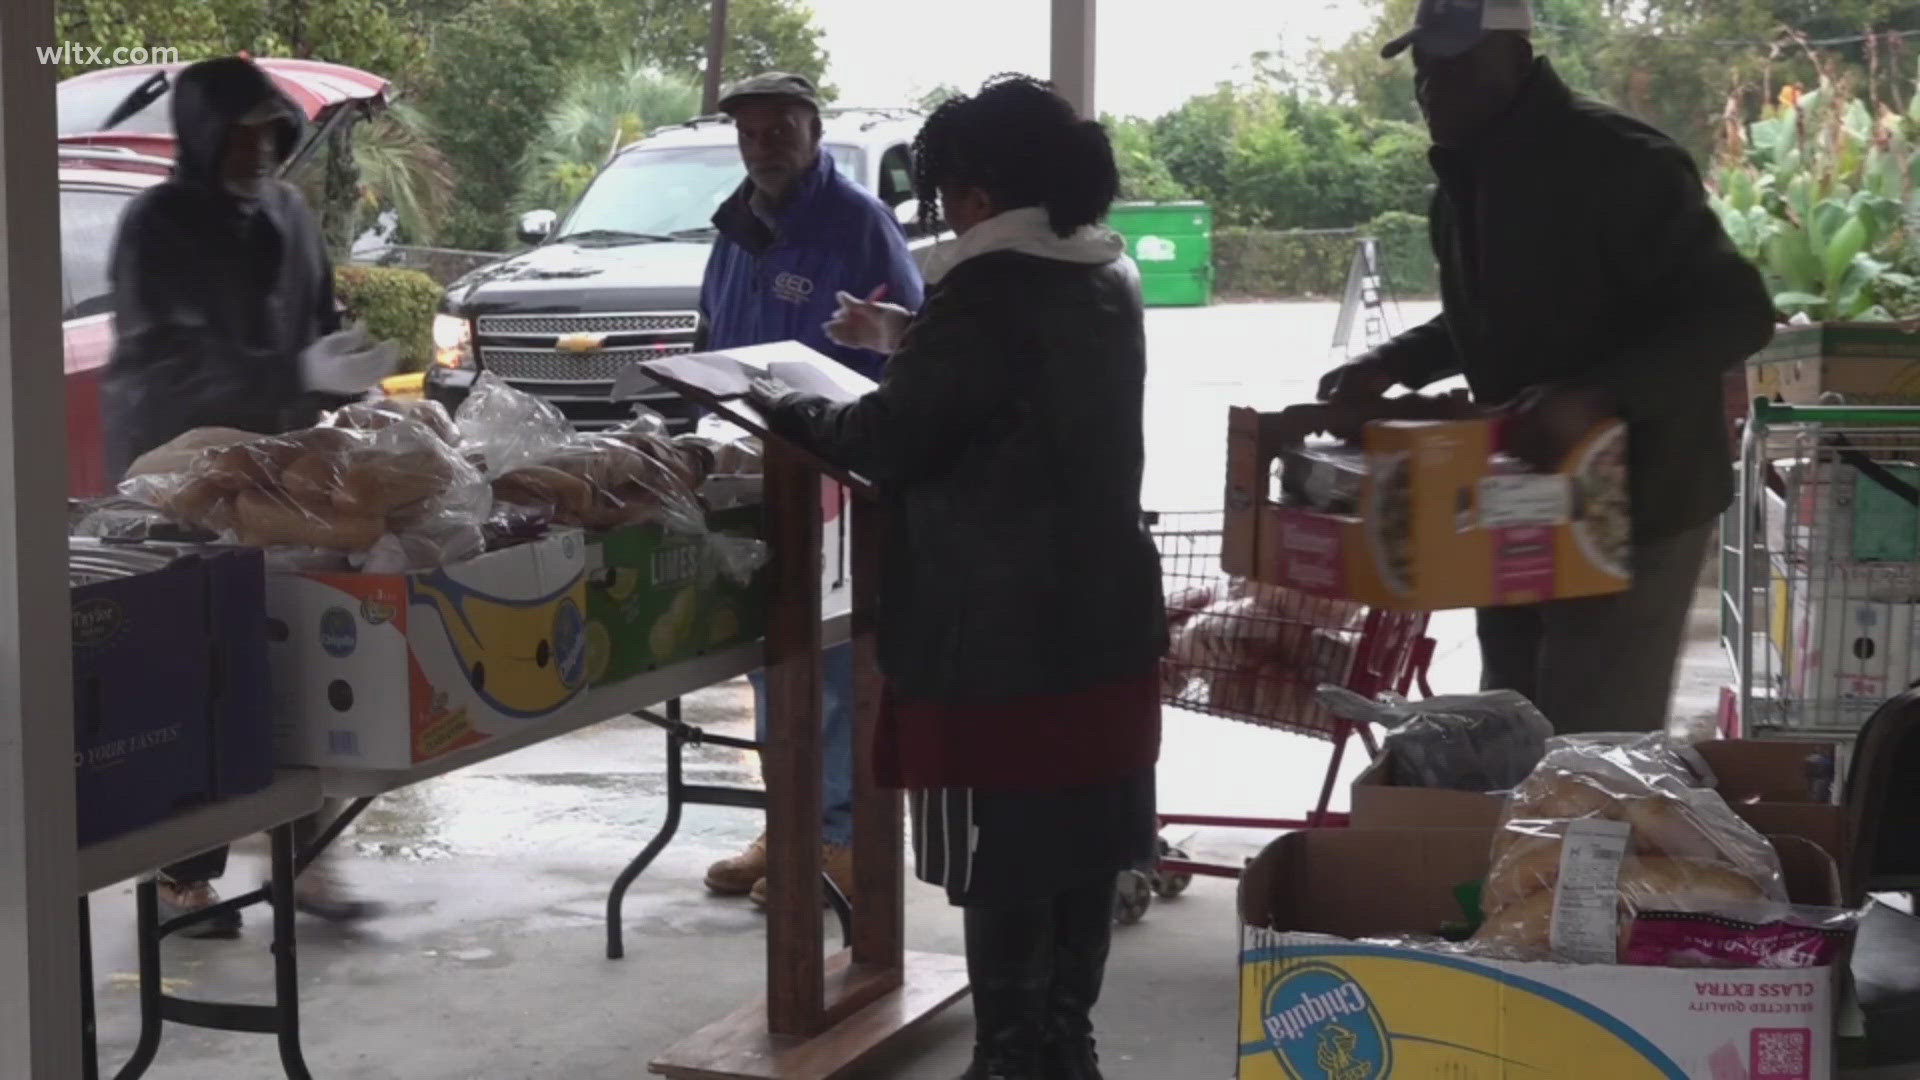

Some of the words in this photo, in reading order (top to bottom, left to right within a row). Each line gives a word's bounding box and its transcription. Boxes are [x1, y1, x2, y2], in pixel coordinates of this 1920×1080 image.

[1695, 982, 1754, 997] EXTRA
[1759, 983, 1814, 997] CLASS
[1264, 981, 1366, 1041] Chiquita
[1688, 1001, 1746, 1013] QUALITY
[1750, 1002, 1814, 1013] SELECTED
